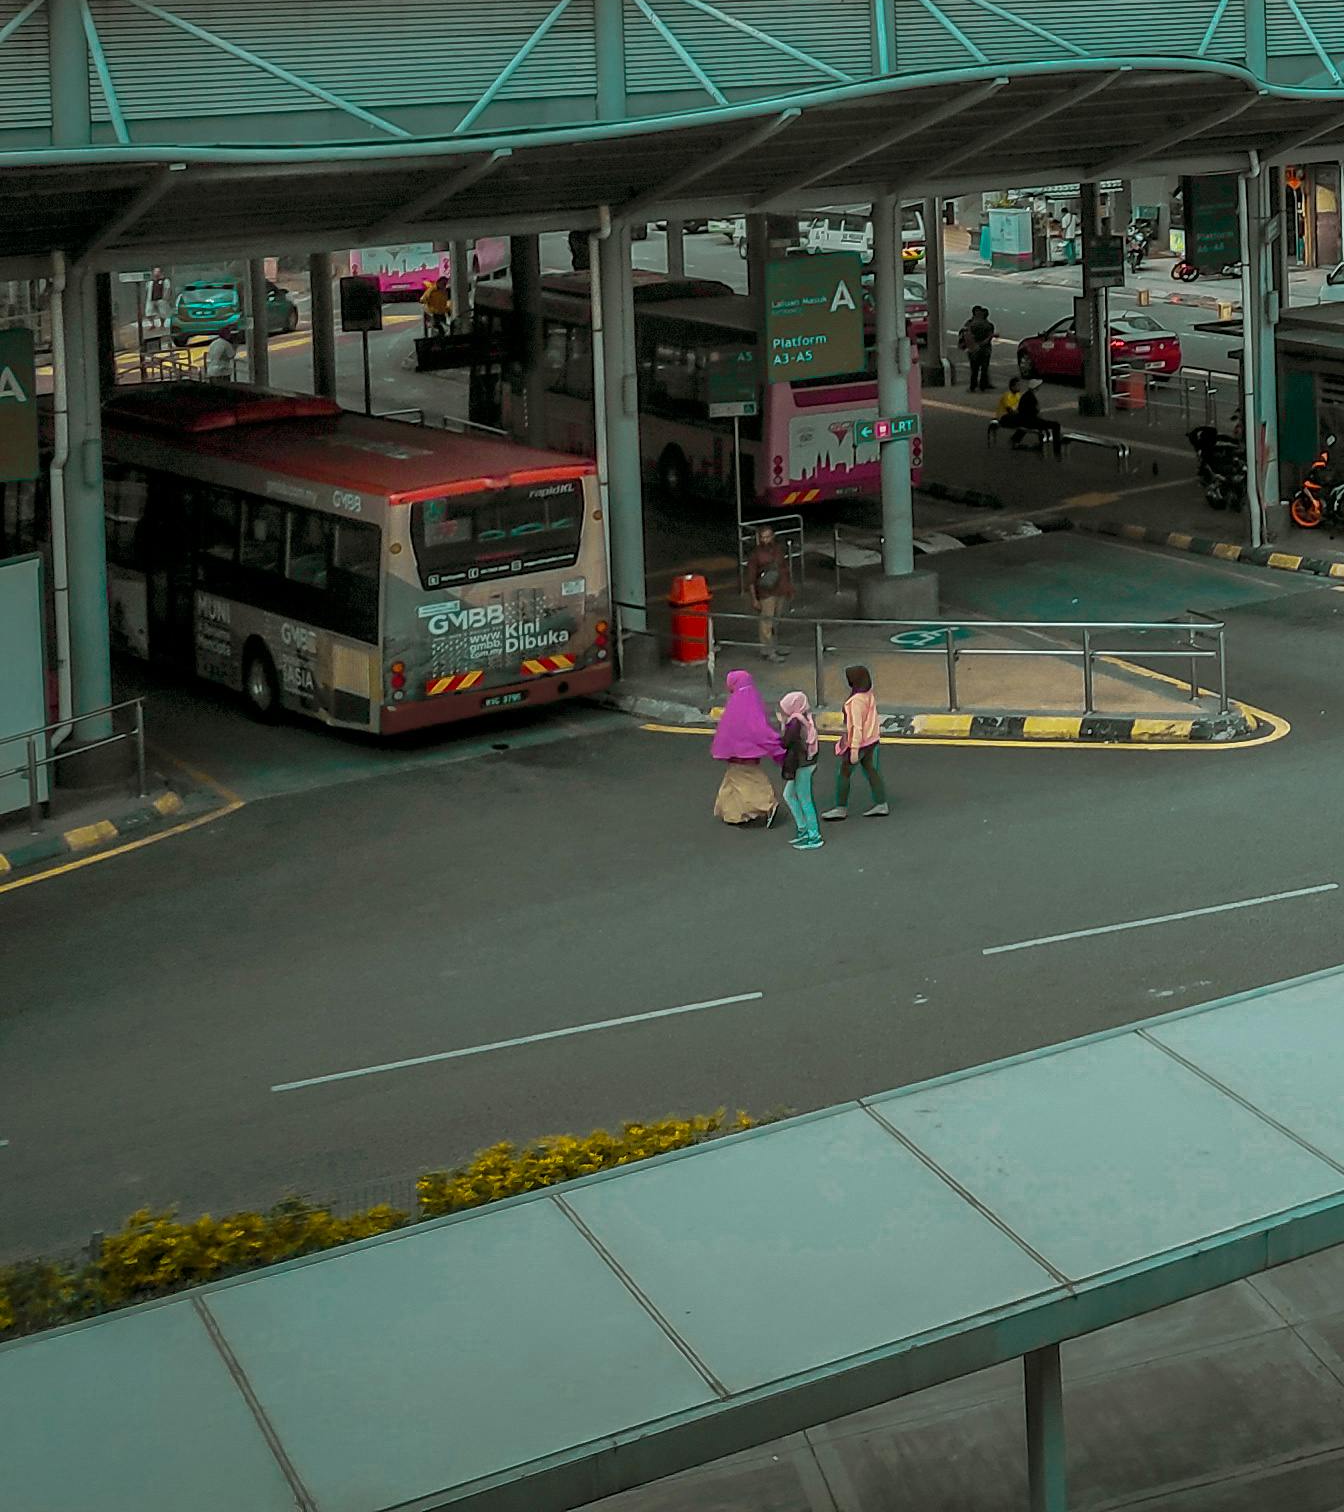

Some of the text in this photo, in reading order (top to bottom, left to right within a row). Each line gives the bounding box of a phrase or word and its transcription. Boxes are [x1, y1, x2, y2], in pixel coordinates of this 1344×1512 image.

[829, 280, 856, 313] A
[772, 333, 828, 350] Platform
[773, 349, 814, 366] A3-A5
[890, 419, 914, 434] LRT
[529, 482, 575, 499] rapidKL
[427, 604, 505, 635] GMBB
[469, 630, 503, 644] www.
[505, 619, 541, 638] Kini
[505, 629, 570, 654] Dibuka
